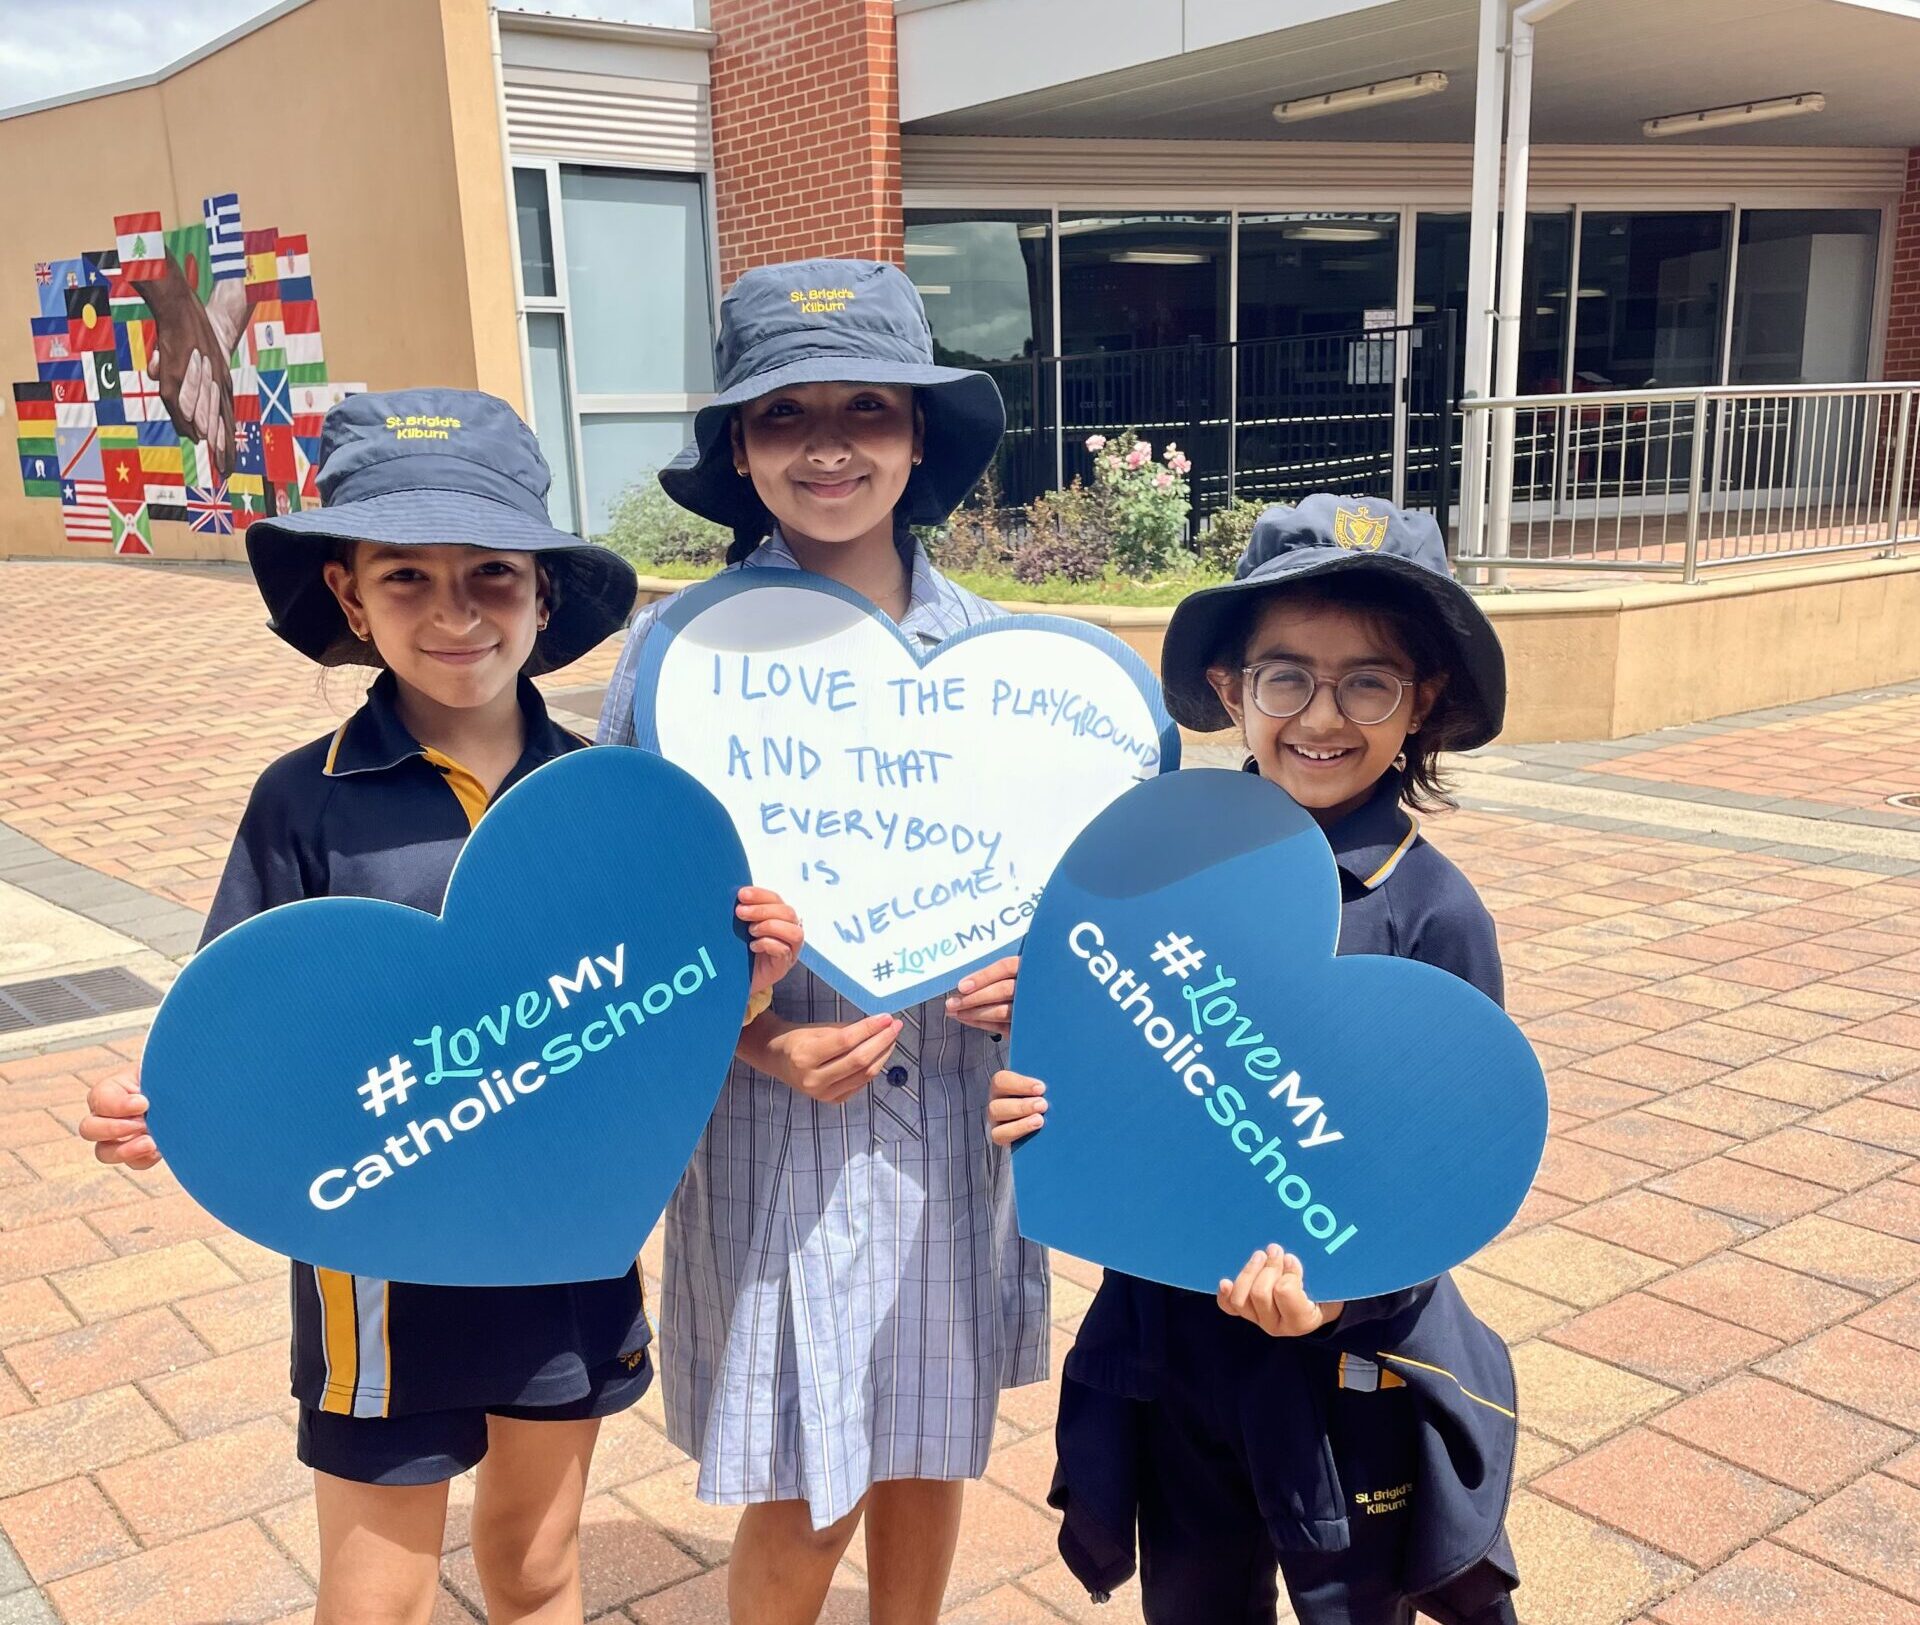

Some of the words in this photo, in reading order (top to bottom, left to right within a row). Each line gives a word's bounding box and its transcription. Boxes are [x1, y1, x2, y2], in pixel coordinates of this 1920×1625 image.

[790, 291, 807, 302] St.
[808, 288, 855, 300] Brigid's
[801, 302, 846, 313] Kilburn
[385, 416, 405, 429] St.
[405, 415, 461, 428] Brigid's
[397, 428, 448, 440] Kilburn
[713, 653, 721, 695] I
[741, 655, 857, 712] LOVE
[887, 677, 965, 717] THE
[992, 678, 1159, 767] PLAYGROUND
[728, 734, 822, 780] AND
[844, 746, 953, 788] THAT
[760, 802, 1002, 869] EVERYBODY
[801, 860, 841, 886] IS
[833, 861, 1020, 944] WELCOME!
[872, 886, 1044, 982] #LoveMyCat
[356, 943, 626, 1118] #LoveMy
[1150, 931, 1345, 1149] #LoveMy
[308, 945, 718, 1212] CatholicSchool
[1068, 921, 1359, 1256] CatholicSchool
[1355, 1493, 1372, 1504] St.
[1373, 1482, 1413, 1501] Brigid's
[1366, 1499, 1407, 1515] Kilburn
